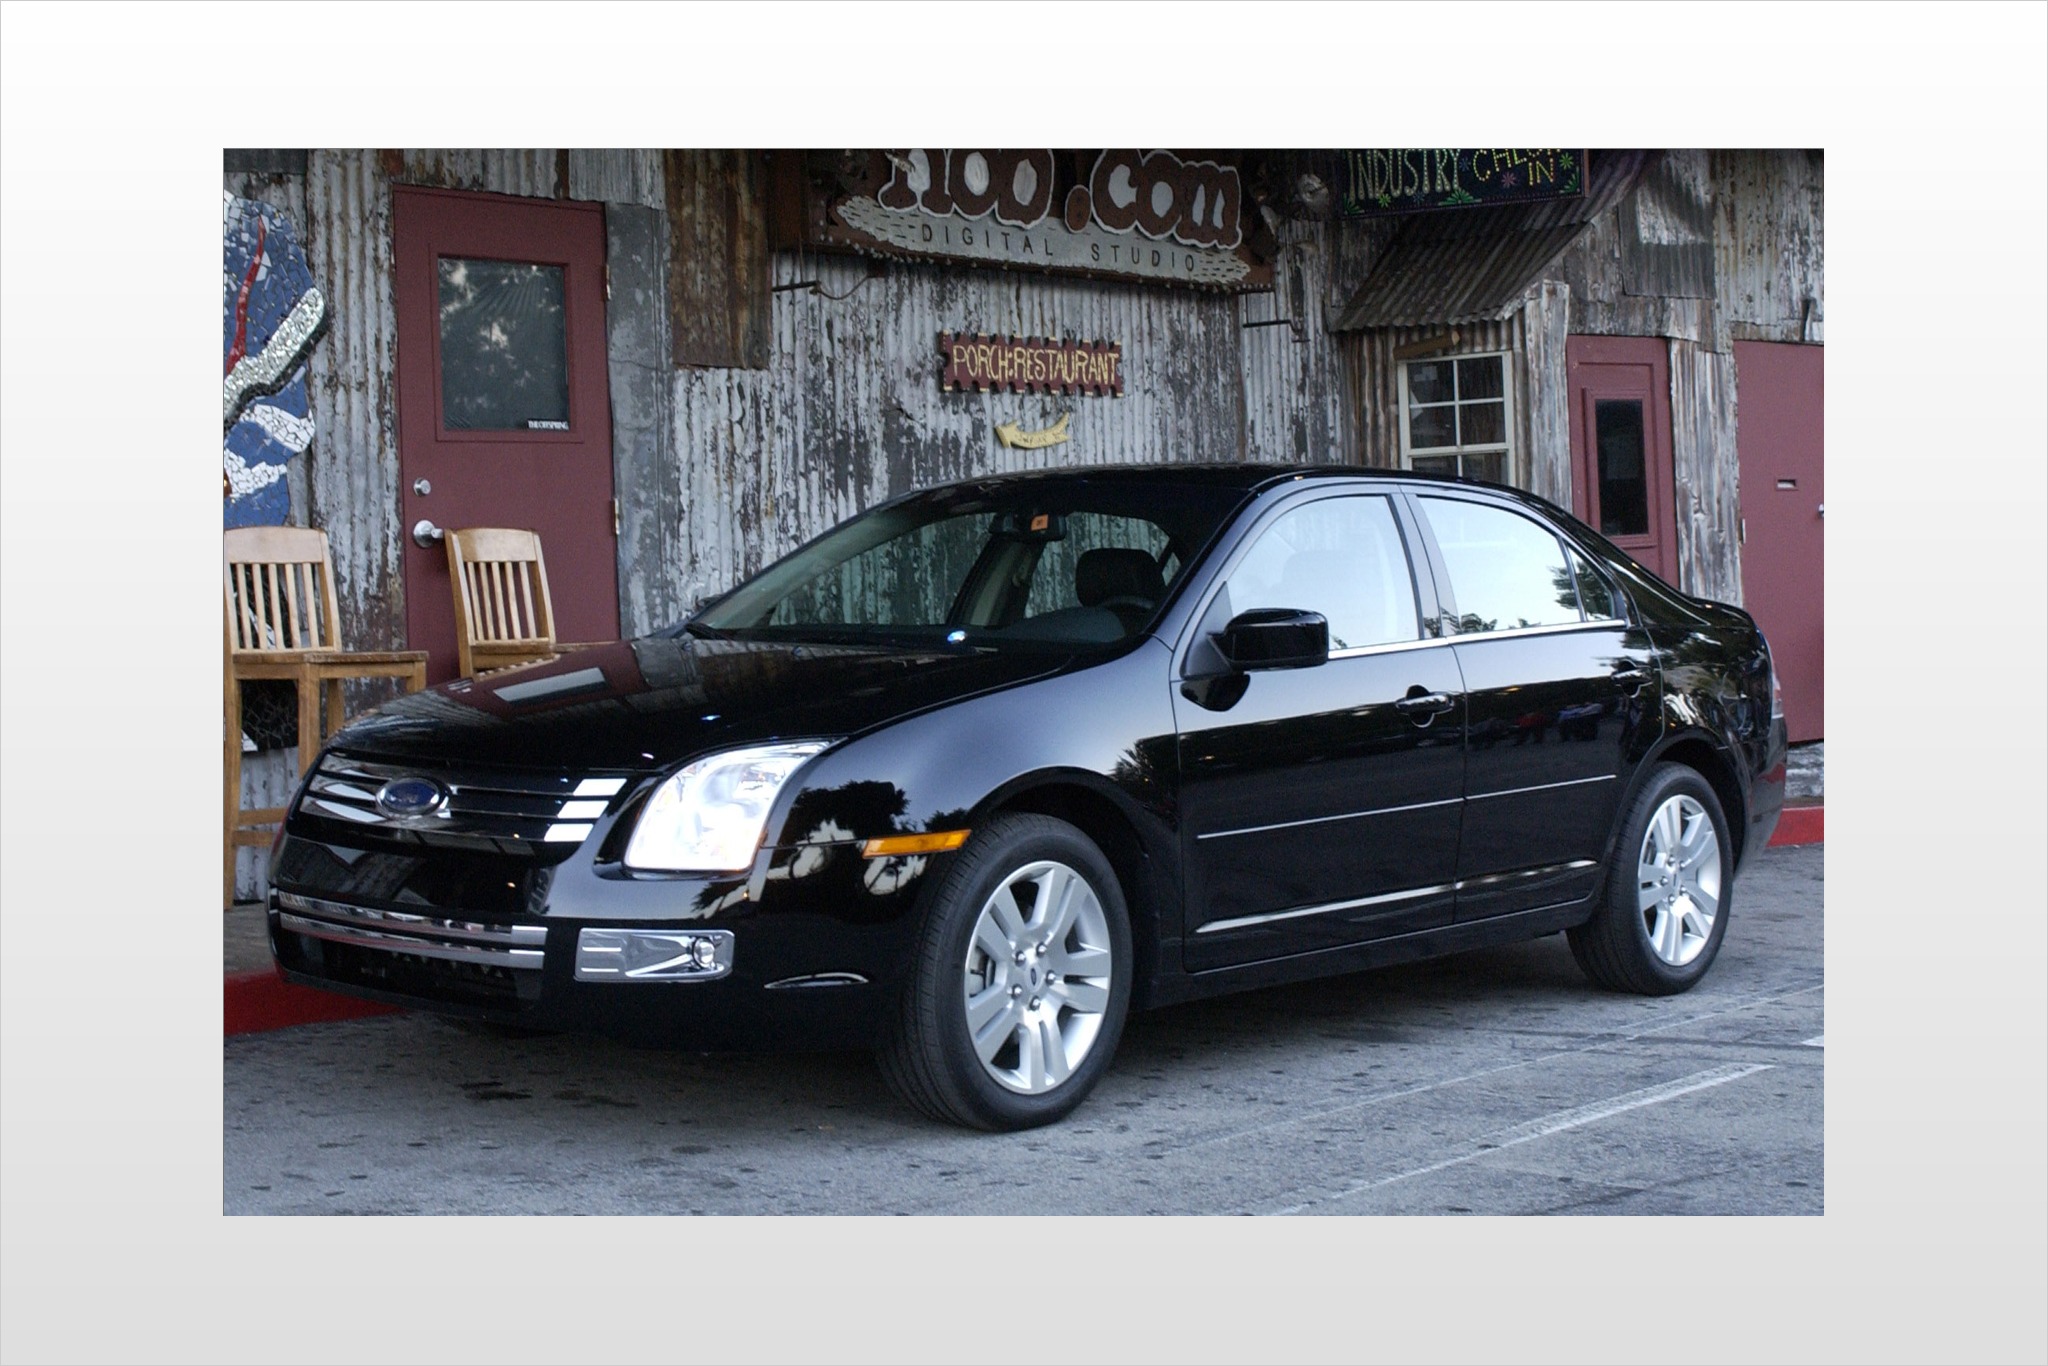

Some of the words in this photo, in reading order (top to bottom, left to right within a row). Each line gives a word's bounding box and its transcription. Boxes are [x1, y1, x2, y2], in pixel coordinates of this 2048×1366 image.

[1527, 157, 1555, 186] IN
[922, 222, 1054, 258] DIGITAL
[1091, 243, 1196, 273] STUDIO
